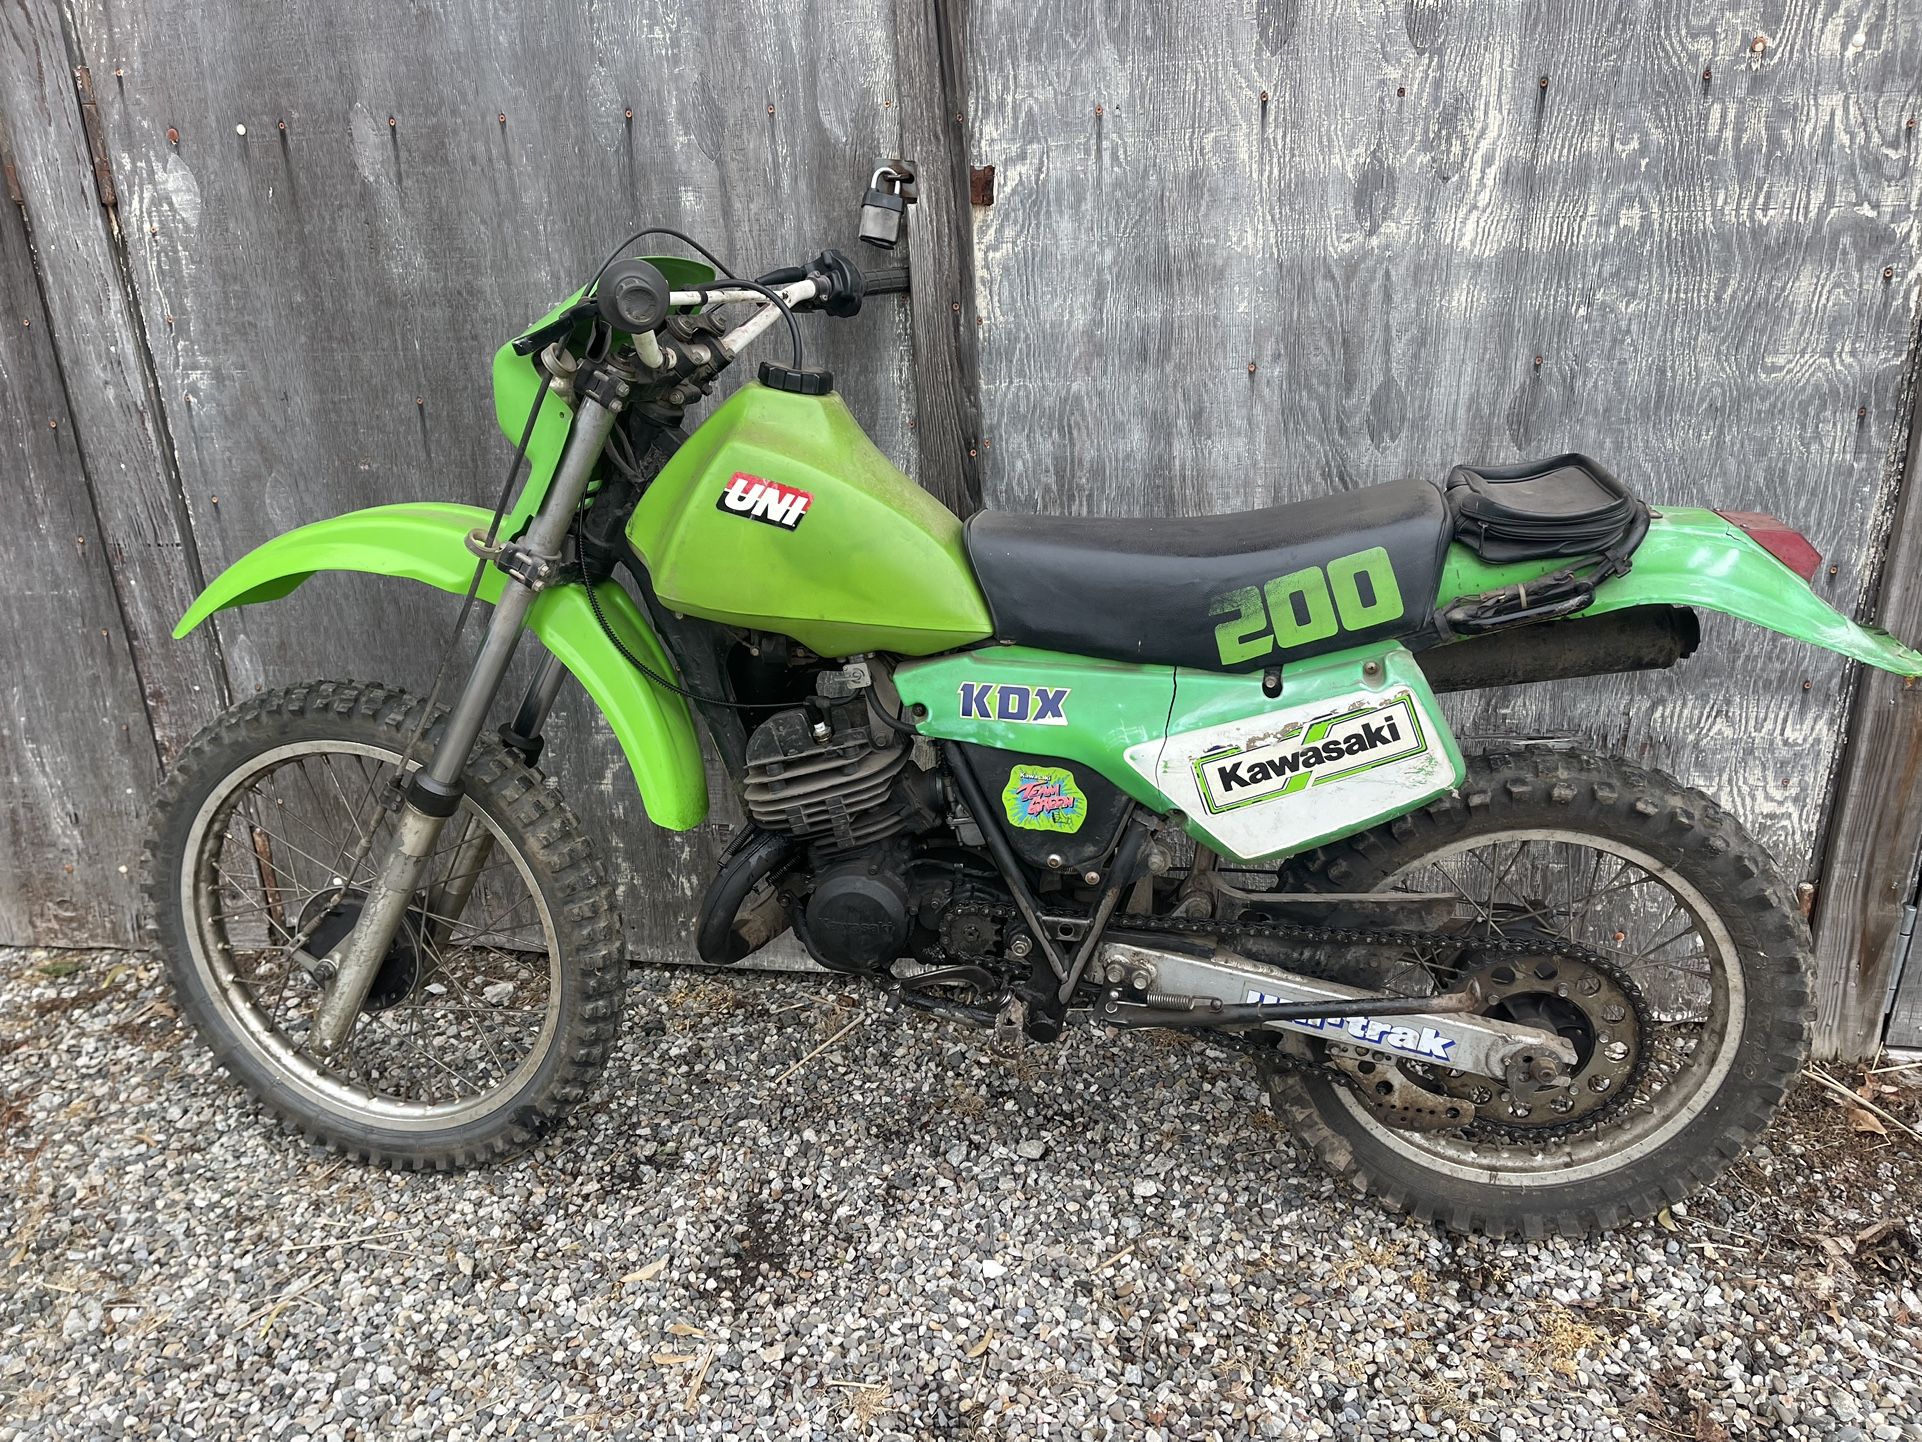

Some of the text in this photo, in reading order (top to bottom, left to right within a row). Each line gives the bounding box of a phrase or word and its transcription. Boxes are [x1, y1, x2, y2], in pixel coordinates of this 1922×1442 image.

[724, 478, 809, 526] UNI
[1208, 546, 1405, 666] 200
[957, 681, 1072, 726] KDX
[1217, 715, 1402, 792] Kawasaki
